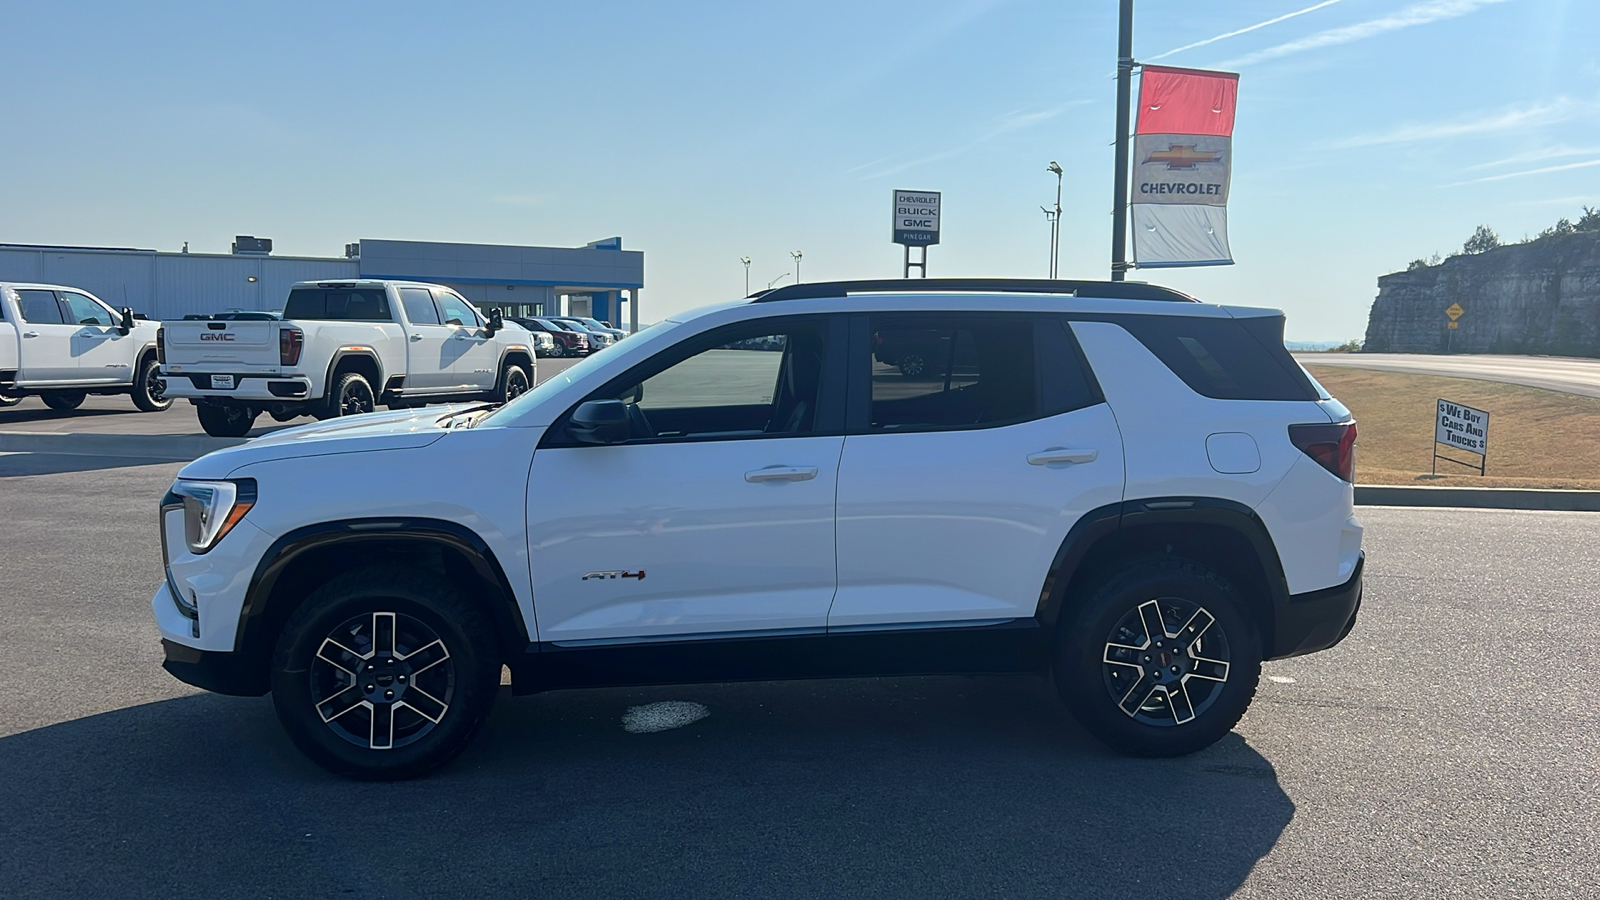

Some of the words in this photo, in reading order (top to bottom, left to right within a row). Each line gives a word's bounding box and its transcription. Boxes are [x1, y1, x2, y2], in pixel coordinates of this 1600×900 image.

[1140, 182, 1221, 195] CHEVROLET
[899, 196, 937, 204] CHEVROLET
[898, 207, 937, 216] BUICK
[903, 219, 932, 227] GMC
[903, 233, 931, 241] PINEGAR
[200, 333, 235, 342] GMC
[582, 569, 646, 581] AT4
